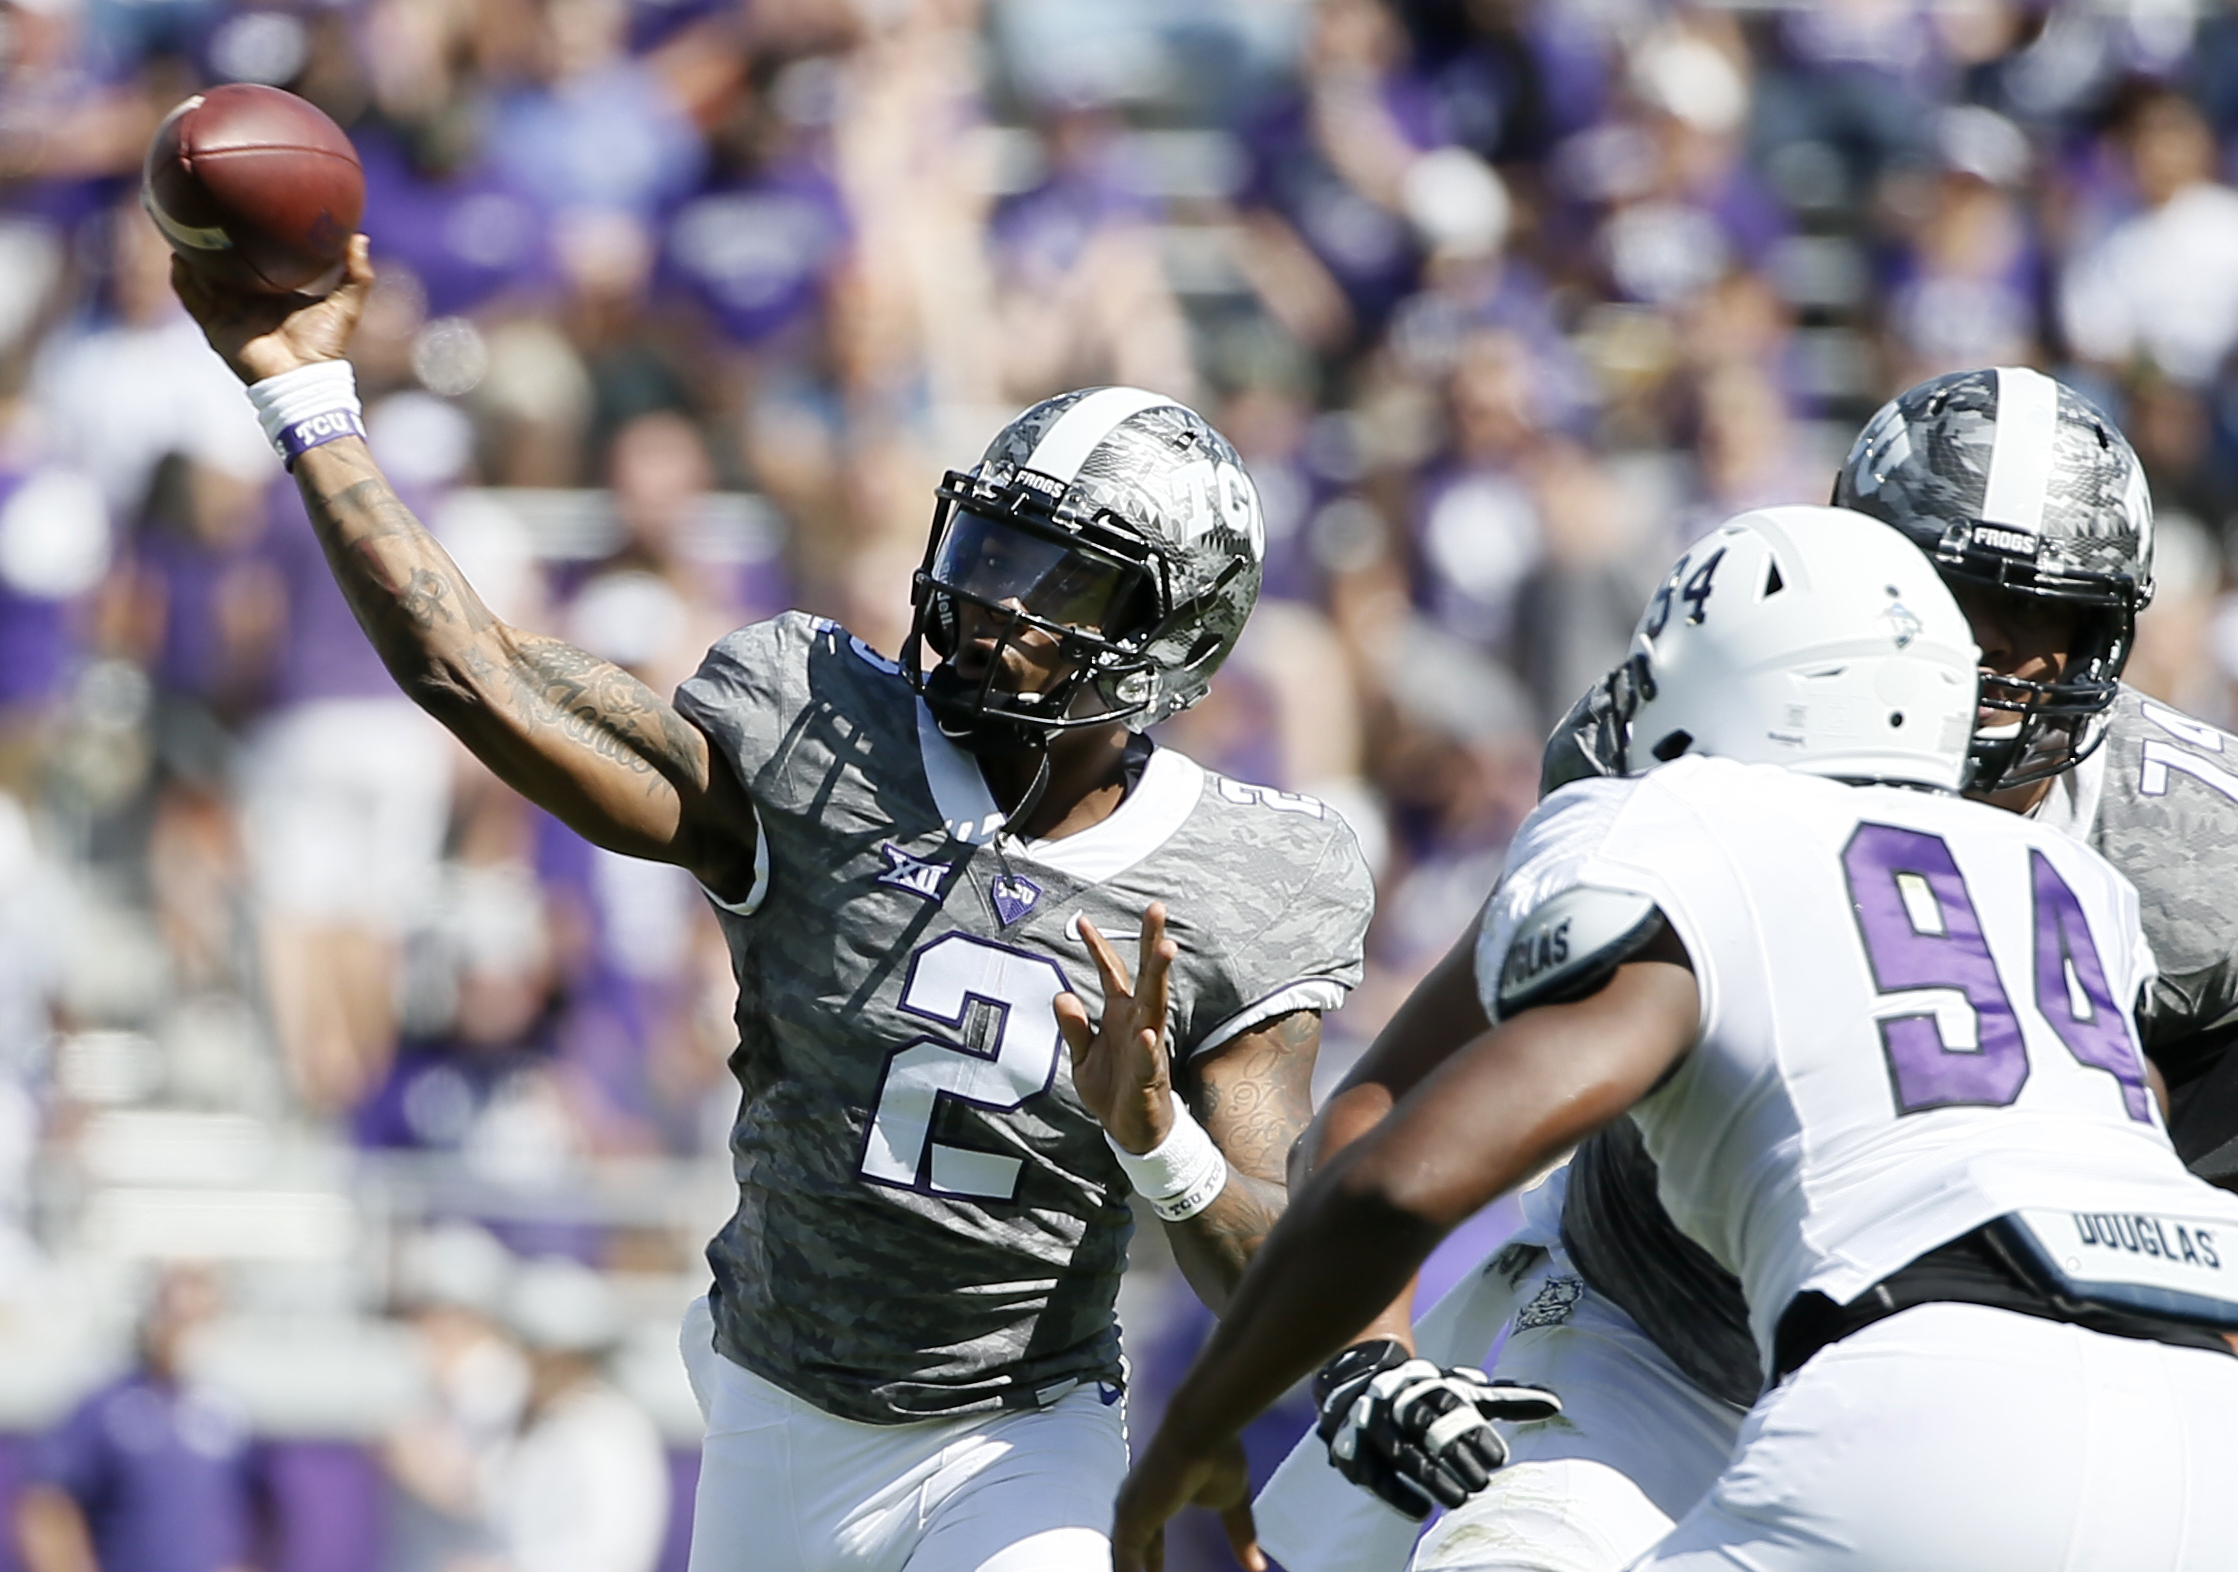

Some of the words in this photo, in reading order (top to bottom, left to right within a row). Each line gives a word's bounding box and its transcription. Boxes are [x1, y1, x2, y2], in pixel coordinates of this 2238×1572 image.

[294, 412, 348, 446] TCU
[1014, 470, 1065, 499] FROGS
[1973, 526, 2036, 554] FROGS
[1840, 820, 2157, 1128] 94
[860, 930, 1073, 1204] 2
[1168, 1192, 1201, 1216] TCU
[2073, 1212, 2220, 1269] DOUGLAS
